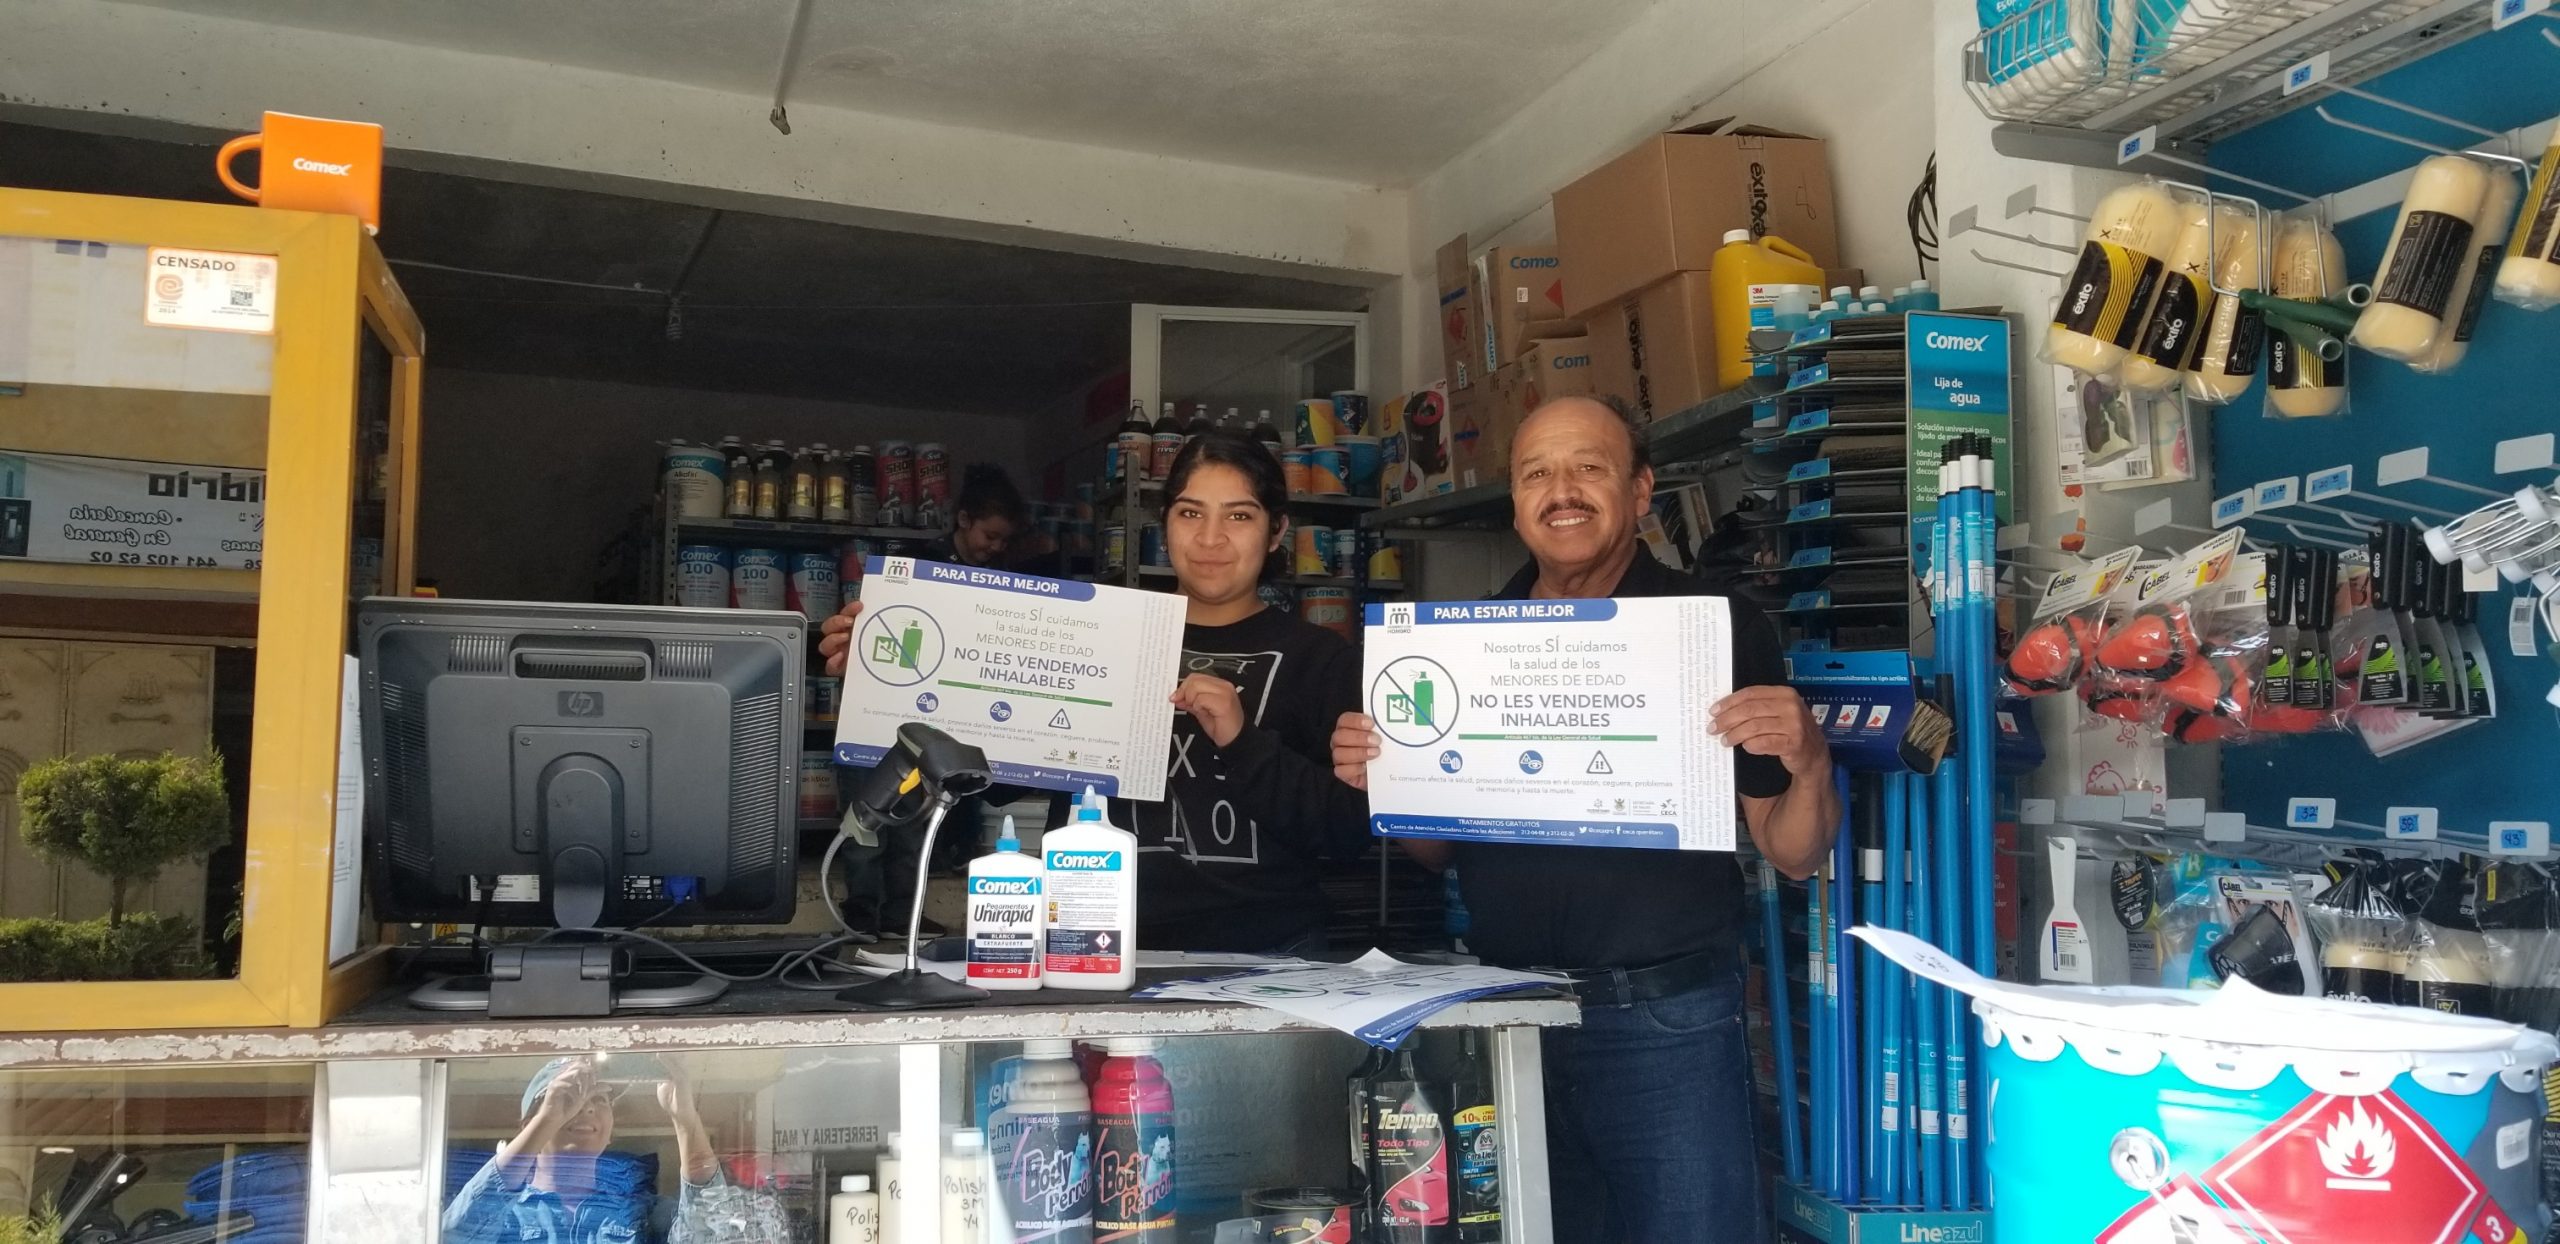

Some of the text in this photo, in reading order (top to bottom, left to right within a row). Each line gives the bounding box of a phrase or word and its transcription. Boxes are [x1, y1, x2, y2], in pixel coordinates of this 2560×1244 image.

[292, 157, 352, 177] Comex
[157, 256, 236, 271] CENSADO
[1926, 331, 1990, 352] Comex
[1554, 355, 1589, 370] Com
[1934, 377, 1963, 390] Lija de
[1950, 393, 1981, 406] agua
[1917, 423, 1944, 431] Solución
[1945, 425, 1974, 433] universal
[1918, 432, 1936, 440] lijado
[1917, 450, 1932, 458] Ideal
[671, 458, 706, 468] Comex
[681, 550, 721, 561] Comex
[738, 554, 777, 566] Comex
[685, 563, 713, 575] 100
[742, 568, 769, 580] 100
[808, 571, 833, 583] 100
[933, 567, 1059, 593] PARA ESTAR MEJOR
[2053, 575, 2077, 588] CABEL
[975, 604, 1099, 630] Nosotros SÍ cuidamos
[1434, 605, 1575, 619] PARA ESTAR MEJOR
[995, 621, 1074, 640] la salud de los
[976, 633, 1094, 658] MENORES DE EDAD
[1484, 635, 1627, 654] Nosotros SÍ cuidamos
[954, 647, 1108, 678] NO LES VENDEMOS
[1510, 658, 1600, 670] la salud de los
[979, 667, 1076, 690] INHALABLES
[1490, 675, 1626, 686] MENORES DE EDAD
[1470, 694, 1646, 709] NO LES VENDEMOS
[1501, 713, 1610, 728] INHALABLES
[1053, 851, 1114, 869] Comex
[975, 878, 1036, 895] Comex
[986, 903, 1028, 912] Pegamentos
[974, 904, 1034, 927] Unirapid
[1378, 1108, 1438, 1133] Tempo
[1377, 1139, 1430, 1148] Todo Tipo
[1023, 1149, 1074, 1203] Body
[1100, 1151, 1150, 1204] Body
[944, 1176, 987, 1196] Polish
[961, 1198, 985, 1210] 3M
[847, 1207, 879, 1226] Polis
[2486, 1216, 2505, 1243] 3
